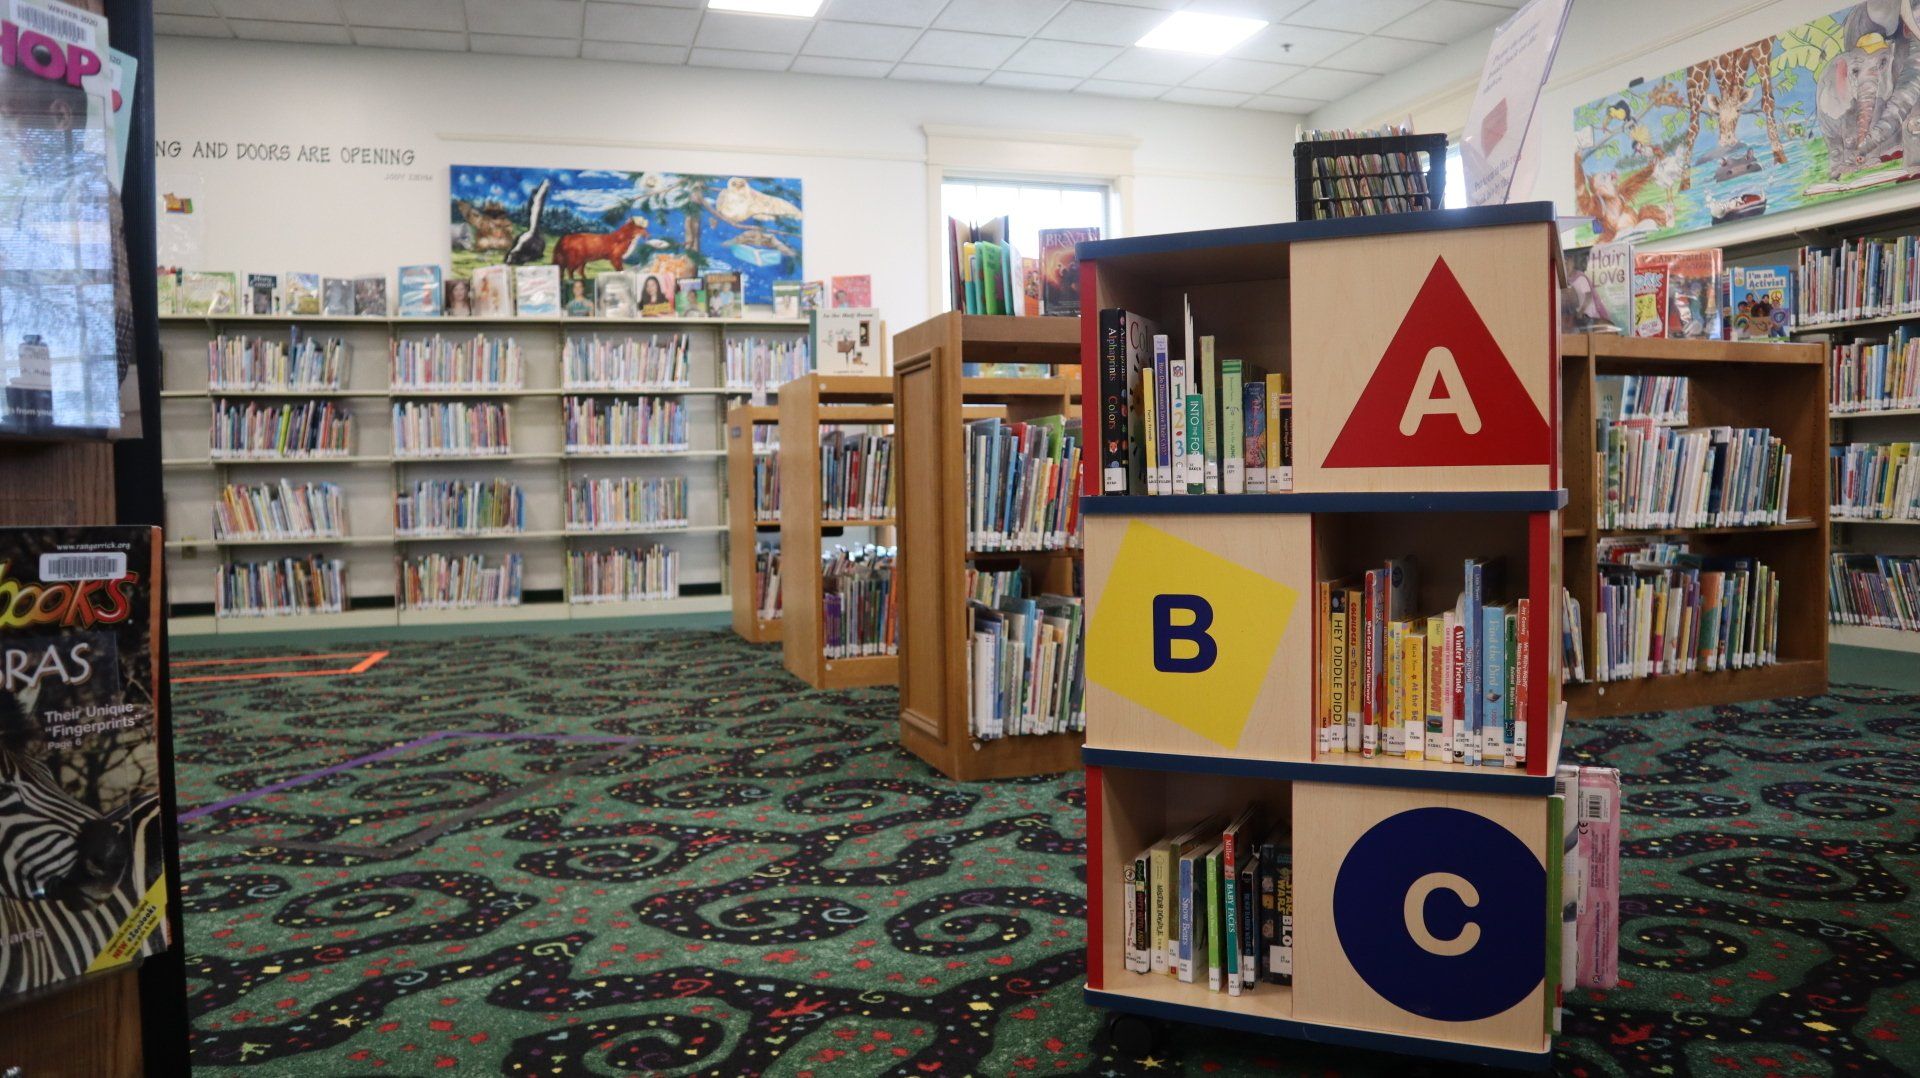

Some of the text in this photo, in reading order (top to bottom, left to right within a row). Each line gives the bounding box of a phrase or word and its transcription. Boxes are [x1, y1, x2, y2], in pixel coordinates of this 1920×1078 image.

[192, 141, 228, 159] AND
[237, 143, 291, 161] DOORS
[297, 147, 331, 163] ARE
[341, 148, 416, 166] OPENING
[1592, 249, 1626, 270] Hair
[1592, 269, 1625, 288] Love
[1749, 278, 1786, 288] Activist
[1107, 327, 1118, 381] Alphaprints
[1399, 346, 1482, 436] A
[1108, 395, 1118, 430] Colors
[1190, 401, 1200, 426] INTO
[57, 541, 131, 551] www.rangerrick.org
[1153, 594, 1217, 673] B
[1334, 620, 1343, 642] HEY
[1488, 620, 1500, 643] Find
[1455, 631, 1464, 694] Winter Friends
[1488, 645, 1500, 663] the
[0, 643, 93, 691] RAS
[1333, 646, 1343, 689] DIDDLE
[1488, 664, 1500, 686] Bird
[1411, 682, 1419, 692] At
[44, 702, 134, 724] Their Unique
[1411, 694, 1419, 707] the
[48, 738, 82, 751] Page 6
[1226, 884, 1236, 933] BABY FACES
[1277, 879, 1285, 914] WARS
[1182, 897, 1191, 945] Snow Bears
[1404, 872, 1481, 956] C
[1282, 915, 1293, 947] BLO
